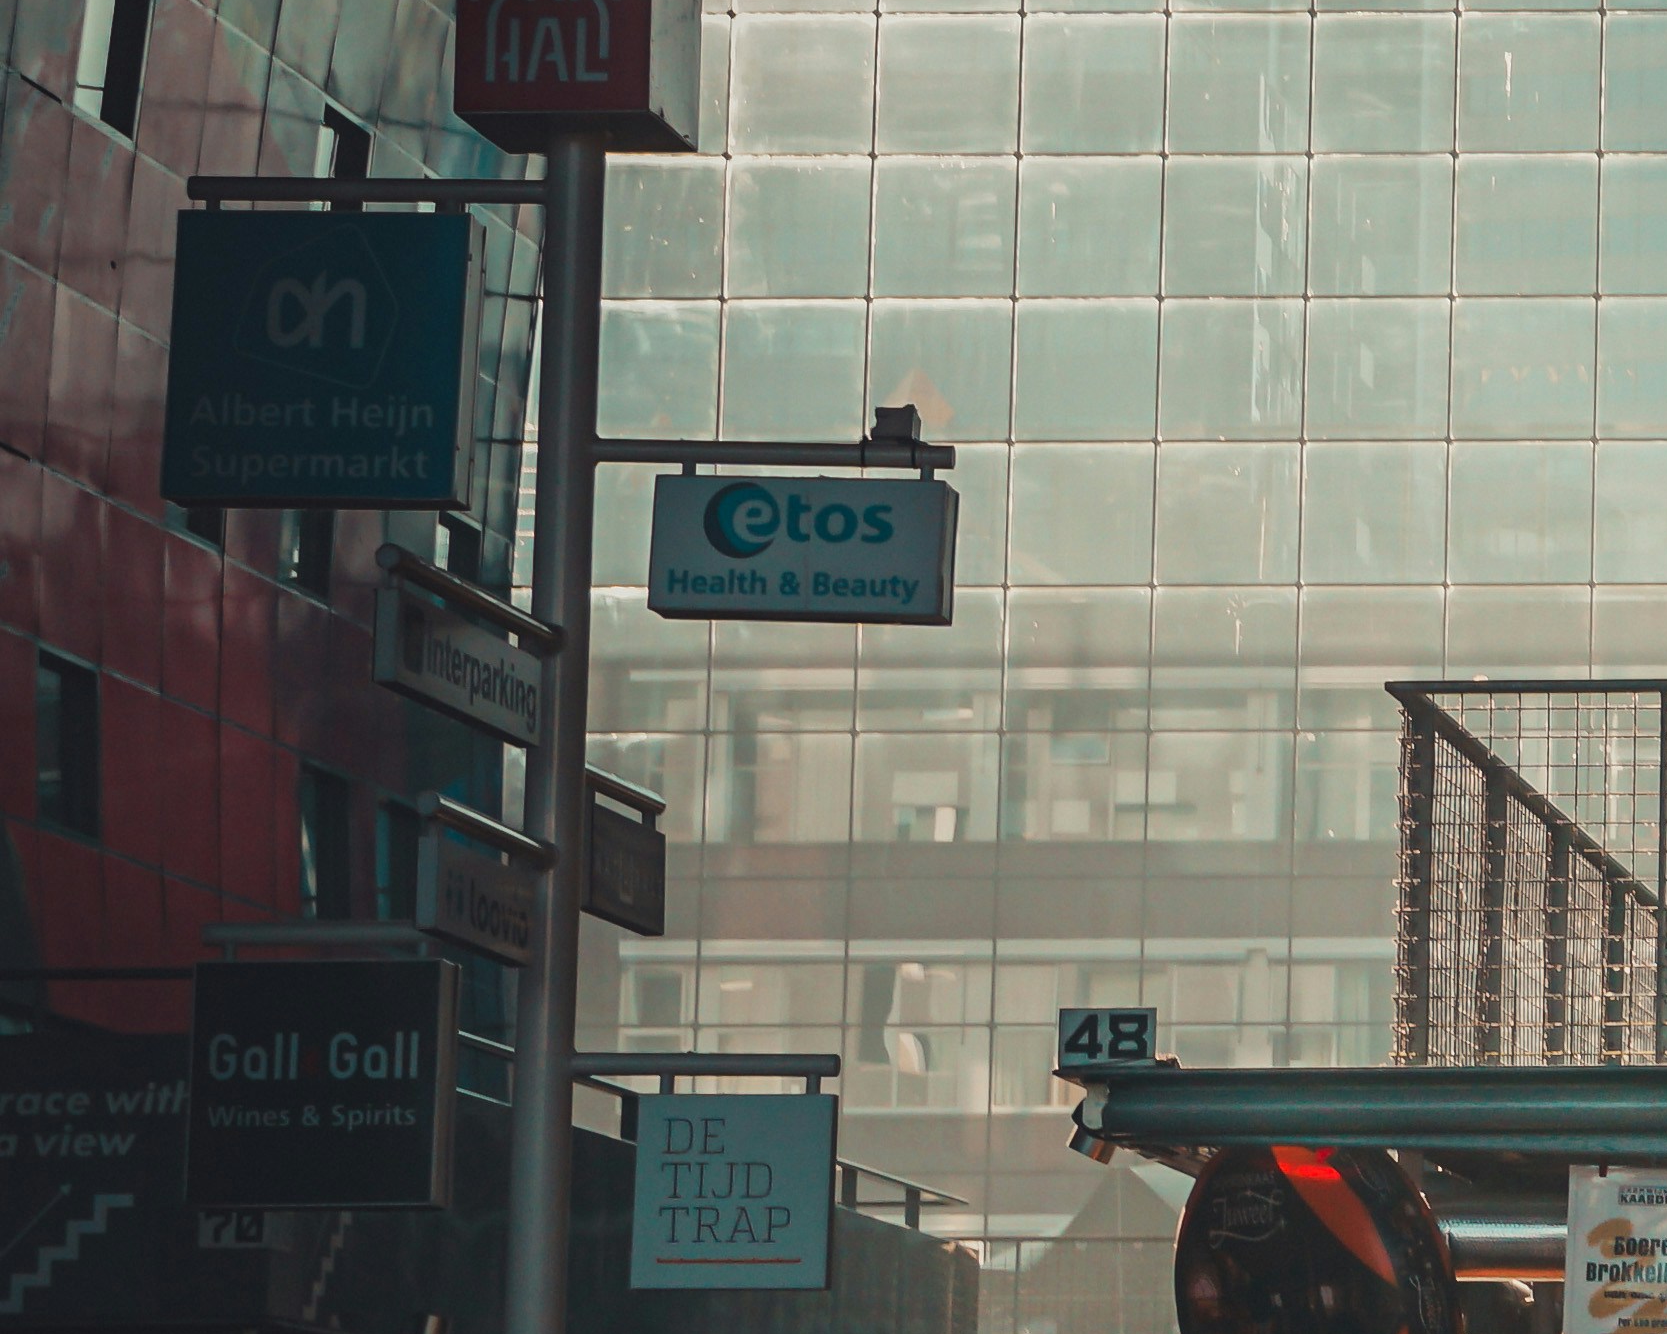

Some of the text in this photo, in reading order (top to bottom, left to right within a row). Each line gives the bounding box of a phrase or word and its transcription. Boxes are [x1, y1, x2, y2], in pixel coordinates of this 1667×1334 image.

[485, 10, 610, 83] HAL
[190, 394, 434, 435] Albert Heijn
[190, 446, 430, 483] Supermarkt
[710, 487, 893, 553] etos
[666, 568, 919, 605] Health & Beauty
[425, 632, 538, 732] Interparking
[1064, 1014, 1148, 1059] 48
[208, 1033, 299, 1081] Gall
[329, 1031, 420, 1080] Gall
[107, 1080, 189, 1116] with
[208, 1105, 417, 1132] Wines & Spirits
[662, 1118, 725, 1155] DE
[34, 1129, 136, 1157] view
[661, 1162, 774, 1199] TIJD
[659, 1206, 792, 1244] TRAP
